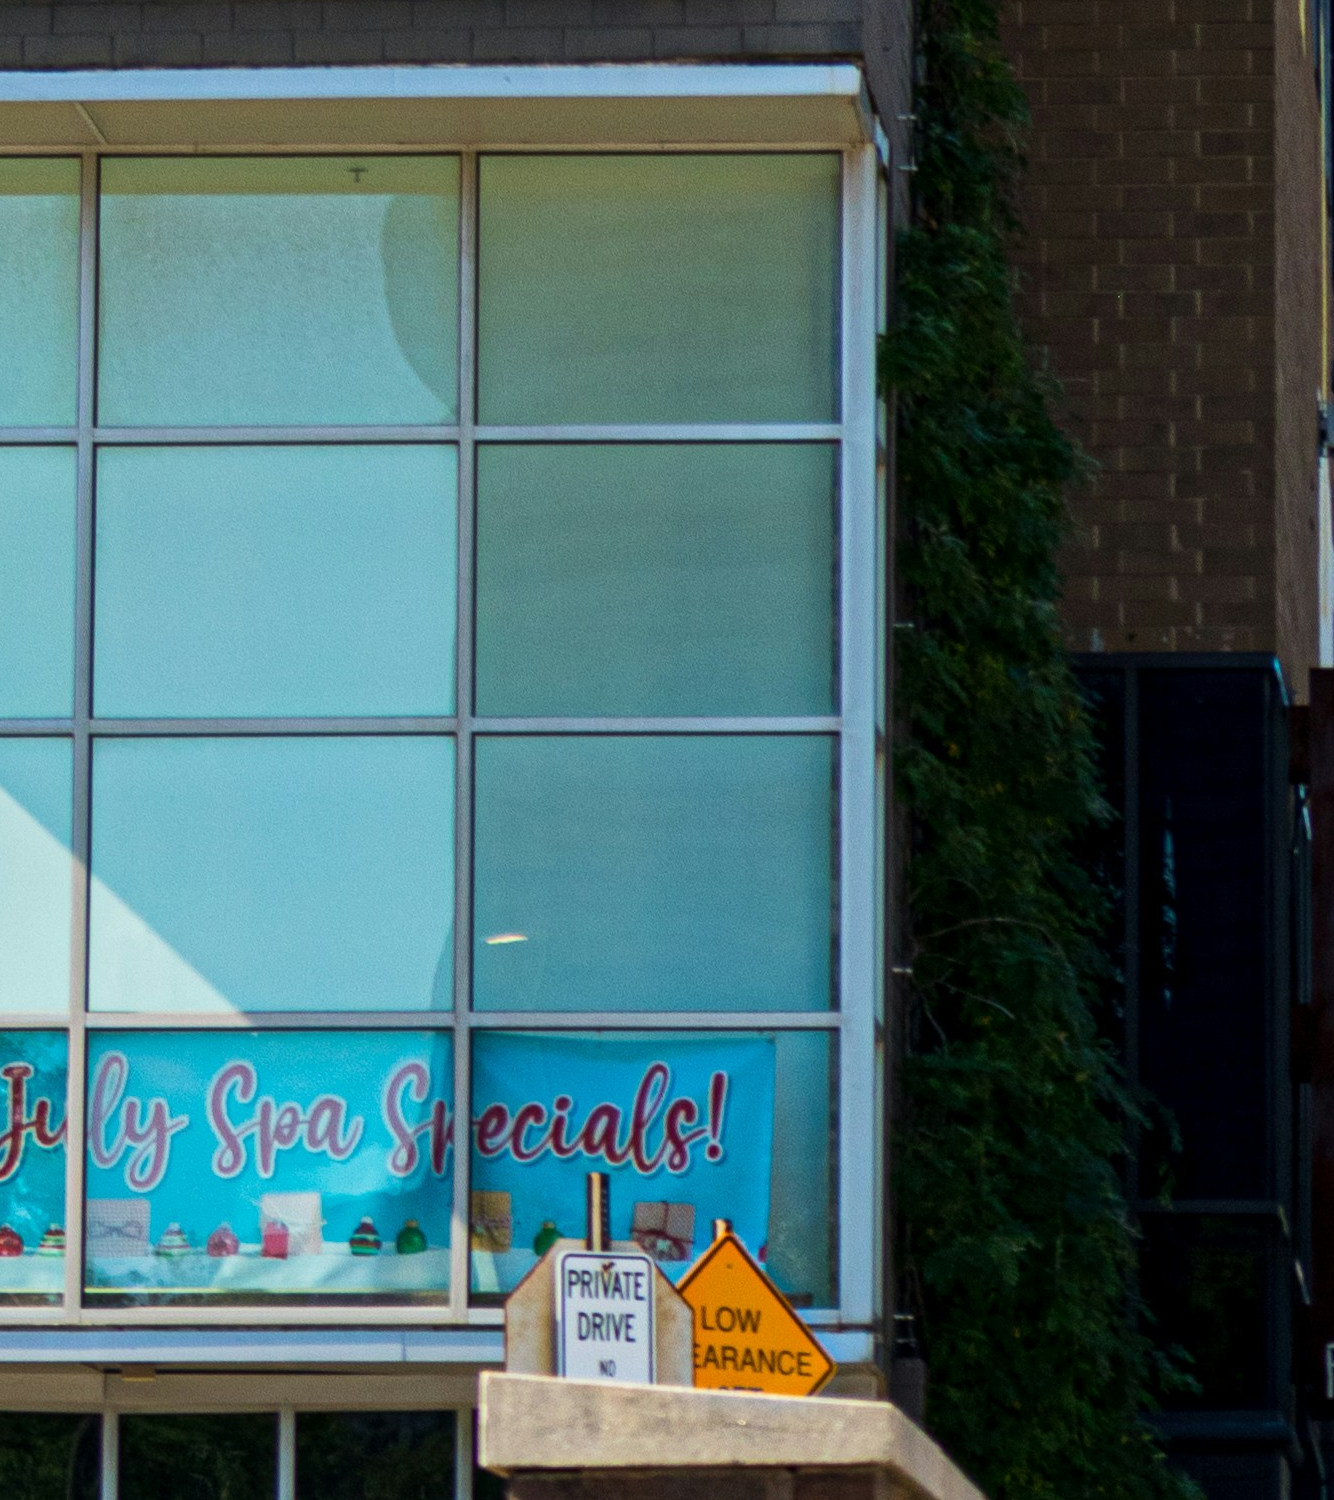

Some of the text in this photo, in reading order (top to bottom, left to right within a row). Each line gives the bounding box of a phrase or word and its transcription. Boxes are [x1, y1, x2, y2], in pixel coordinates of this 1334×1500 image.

[206, 1059, 363, 1181] Spa
[567, 1269, 646, 1301] PRIVATE
[578, 1312, 637, 1343] DRIVE
[700, 1305, 762, 1334] LOW
[598, 1360, 616, 1378] NO
[694, 1344, 813, 1377] EARANCE
